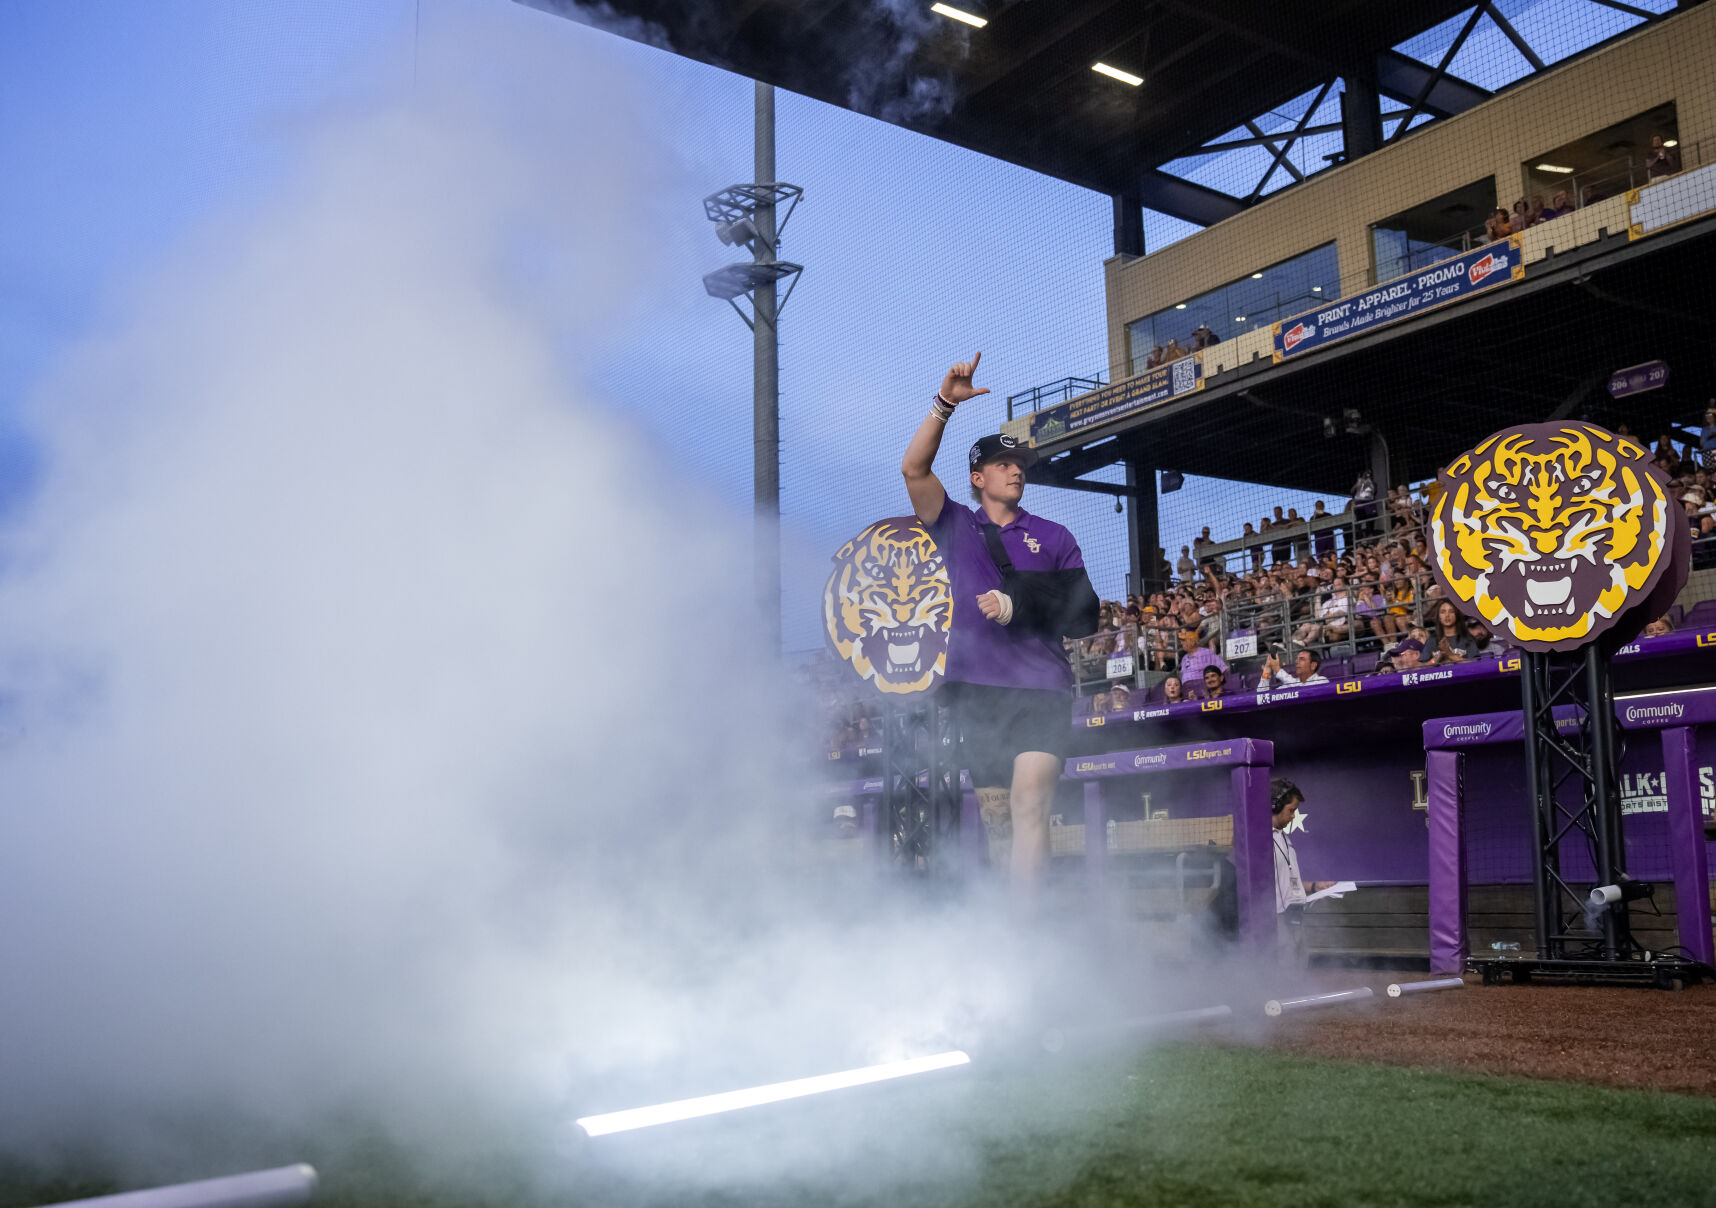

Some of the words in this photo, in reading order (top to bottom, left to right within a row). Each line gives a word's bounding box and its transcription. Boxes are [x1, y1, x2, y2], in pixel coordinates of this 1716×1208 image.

[1318, 304, 1350, 326] PRINT
[1358, 282, 1411, 311] APPAREL
[1418, 262, 1465, 290] PROMO
[1323, 321, 1350, 338] Brands
[1350, 313, 1374, 328] Made
[1375, 302, 1407, 318] Brighter
[1407, 296, 1421, 310] for
[1422, 290, 1434, 303] 25
[1436, 283, 1460, 298] Years
[1152, 369, 1168, 380] YOUR
[1649, 369, 1665, 381] 207
[1611, 381, 1628, 391] 206
[1023, 532, 1041, 554] LSU
[1696, 633, 1716, 647] LS
[1234, 643, 1250, 655] 207
[1615, 644, 1641, 656] TALS
[1112, 663, 1127, 674] 206
[1498, 658, 1521, 673] LS
[1420, 670, 1453, 682] RENTALS
[1336, 681, 1362, 695] LSU
[1271, 691, 1299, 702] RENTALS
[1201, 700, 1223, 712] LSU
[1626, 702, 1685, 722] Community
[1145, 708, 1170, 718] RENTALS
[1086, 716, 1105, 727] LSU
[1443, 721, 1492, 739] Community
[1134, 752, 1167, 767] Community
